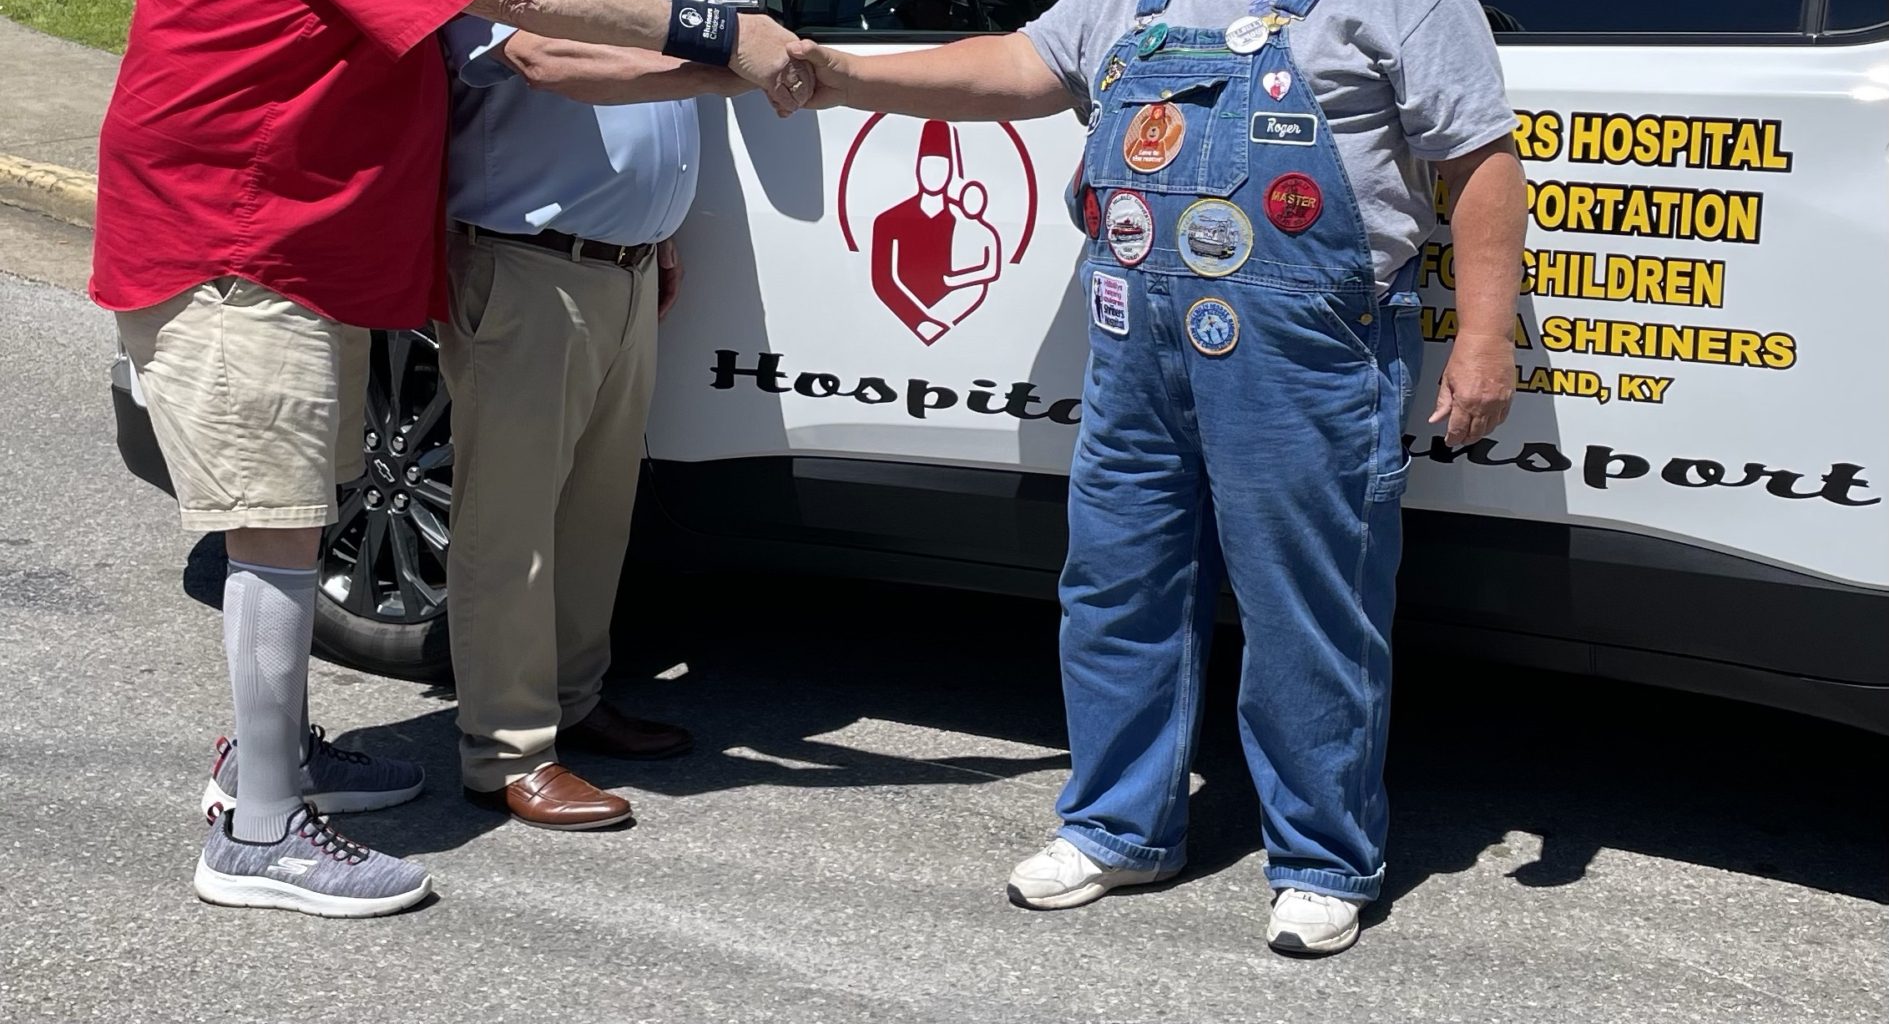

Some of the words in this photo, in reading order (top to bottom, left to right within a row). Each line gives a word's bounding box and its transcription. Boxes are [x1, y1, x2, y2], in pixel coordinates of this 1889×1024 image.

[1266, 117, 1302, 138] Roger
[1569, 111, 1792, 173] HOSPITAL
[1271, 190, 1317, 209] MASTER
[1543, 316, 1798, 371] SHRINERS
[1618, 376, 1675, 405] KY
